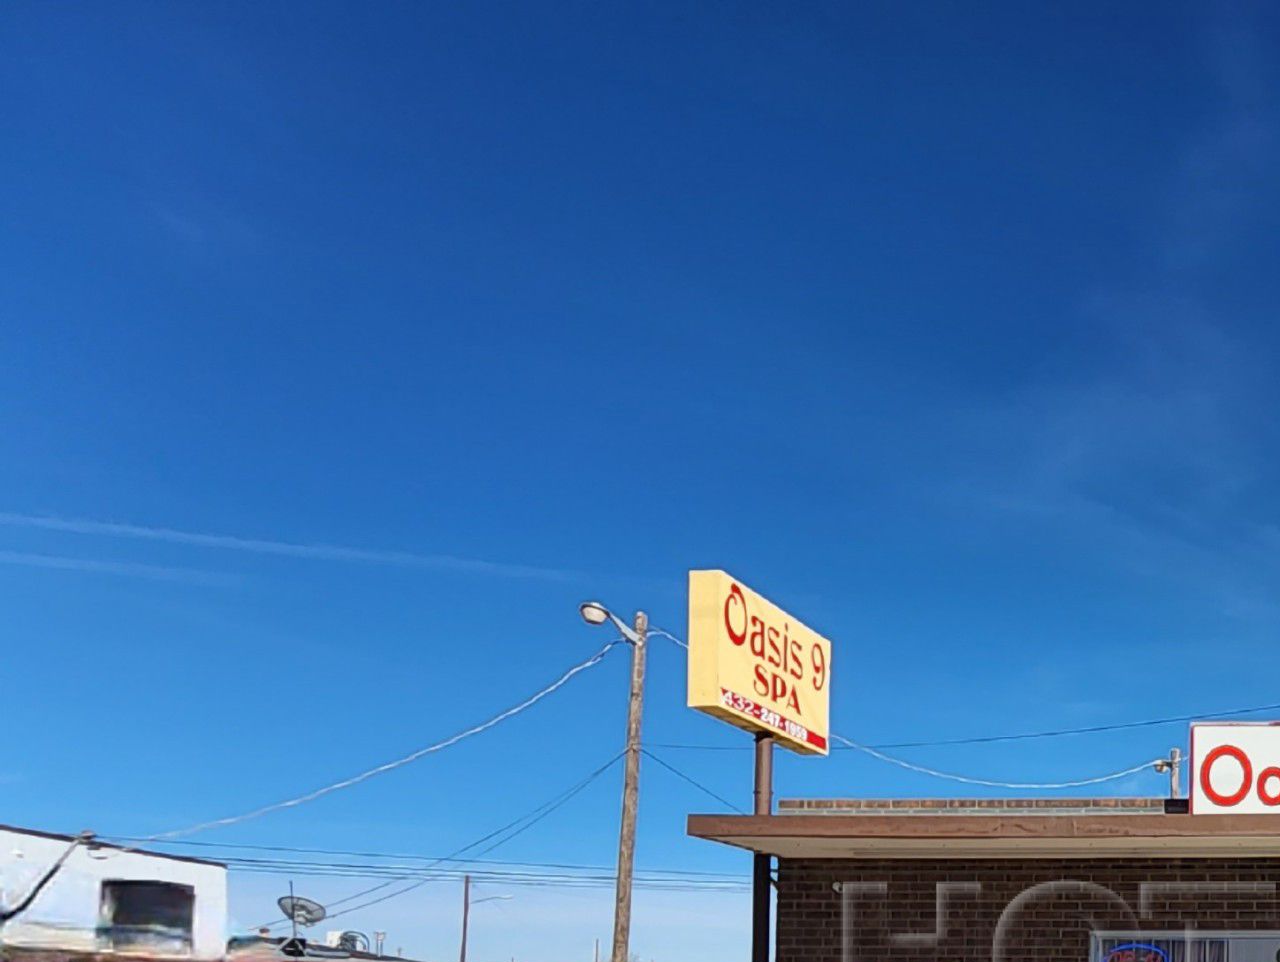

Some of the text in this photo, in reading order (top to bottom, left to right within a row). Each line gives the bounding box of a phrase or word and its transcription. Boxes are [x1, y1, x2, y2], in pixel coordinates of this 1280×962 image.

[724, 583, 826, 691] Oasis 9
[753, 663, 802, 716] SPA
